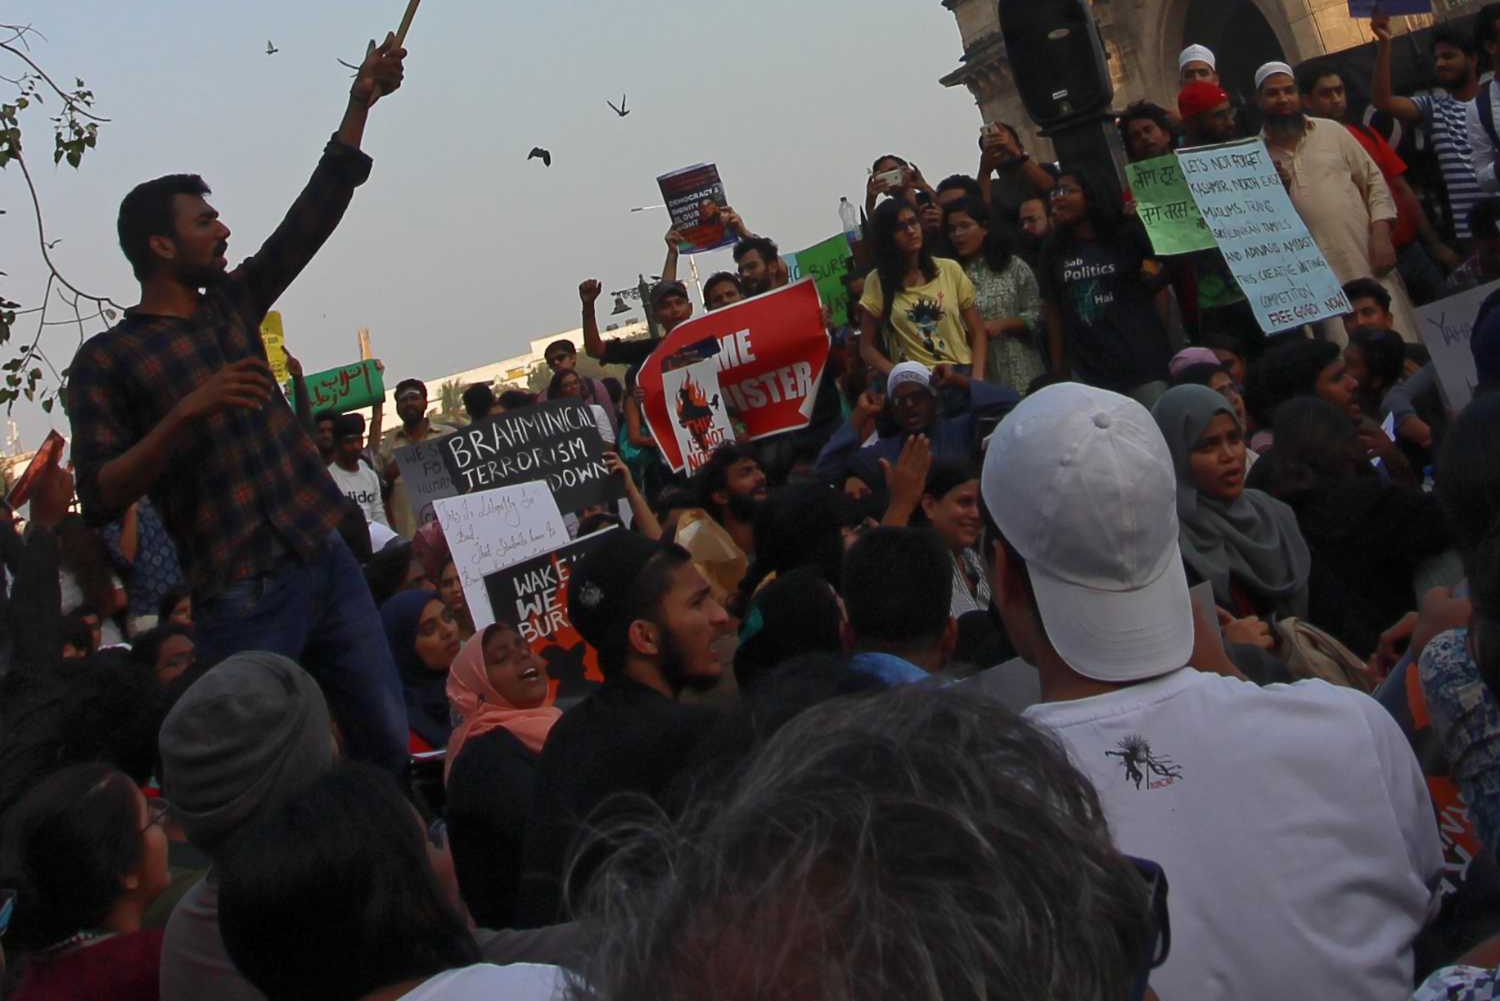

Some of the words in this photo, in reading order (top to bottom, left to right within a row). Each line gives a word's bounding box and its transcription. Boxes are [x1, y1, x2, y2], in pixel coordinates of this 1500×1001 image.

[1063, 263, 1116, 283] Politics
[448, 405, 597, 469] BRAHMINICAL
[461, 436, 589, 490] TERRORISM
[549, 458, 610, 493] DOWN
[512, 558, 570, 598] WAKE
